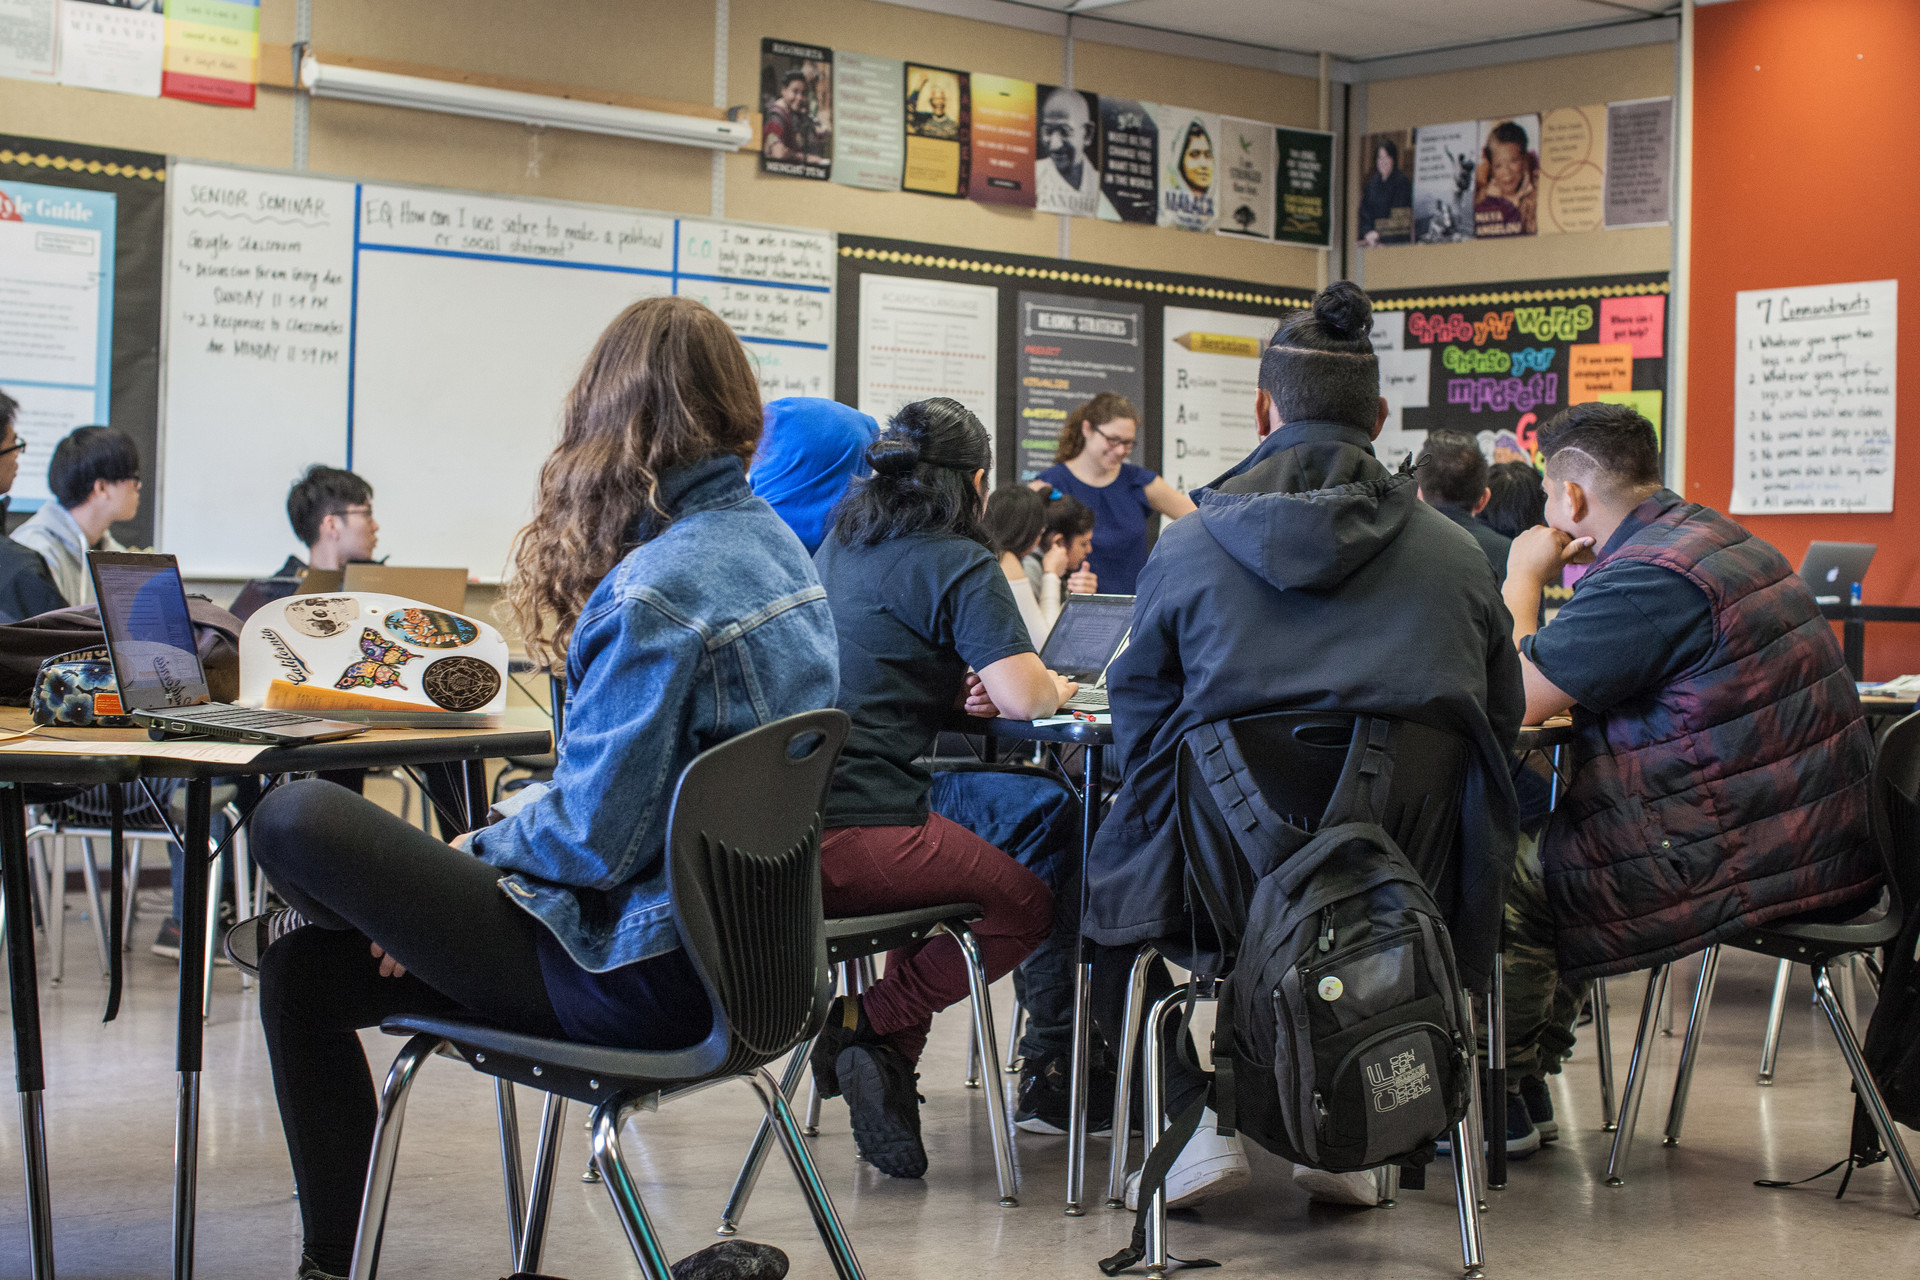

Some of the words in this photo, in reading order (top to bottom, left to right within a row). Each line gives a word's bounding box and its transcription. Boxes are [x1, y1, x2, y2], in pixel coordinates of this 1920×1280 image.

[0, 193, 33, 220] yle
[36, 199, 93, 222] Guide
[190, 185, 249, 206] SENIOR
[257, 191, 330, 217] SEMINAR
[400, 200, 426, 225] How
[457, 206, 466, 228] I
[1757, 298, 1772, 325] 7
[1779, 292, 1871, 321] Commandments
[1408, 311, 1473, 344] Change
[1442, 345, 1511, 374] Change
[261, 627, 312, 686] California
